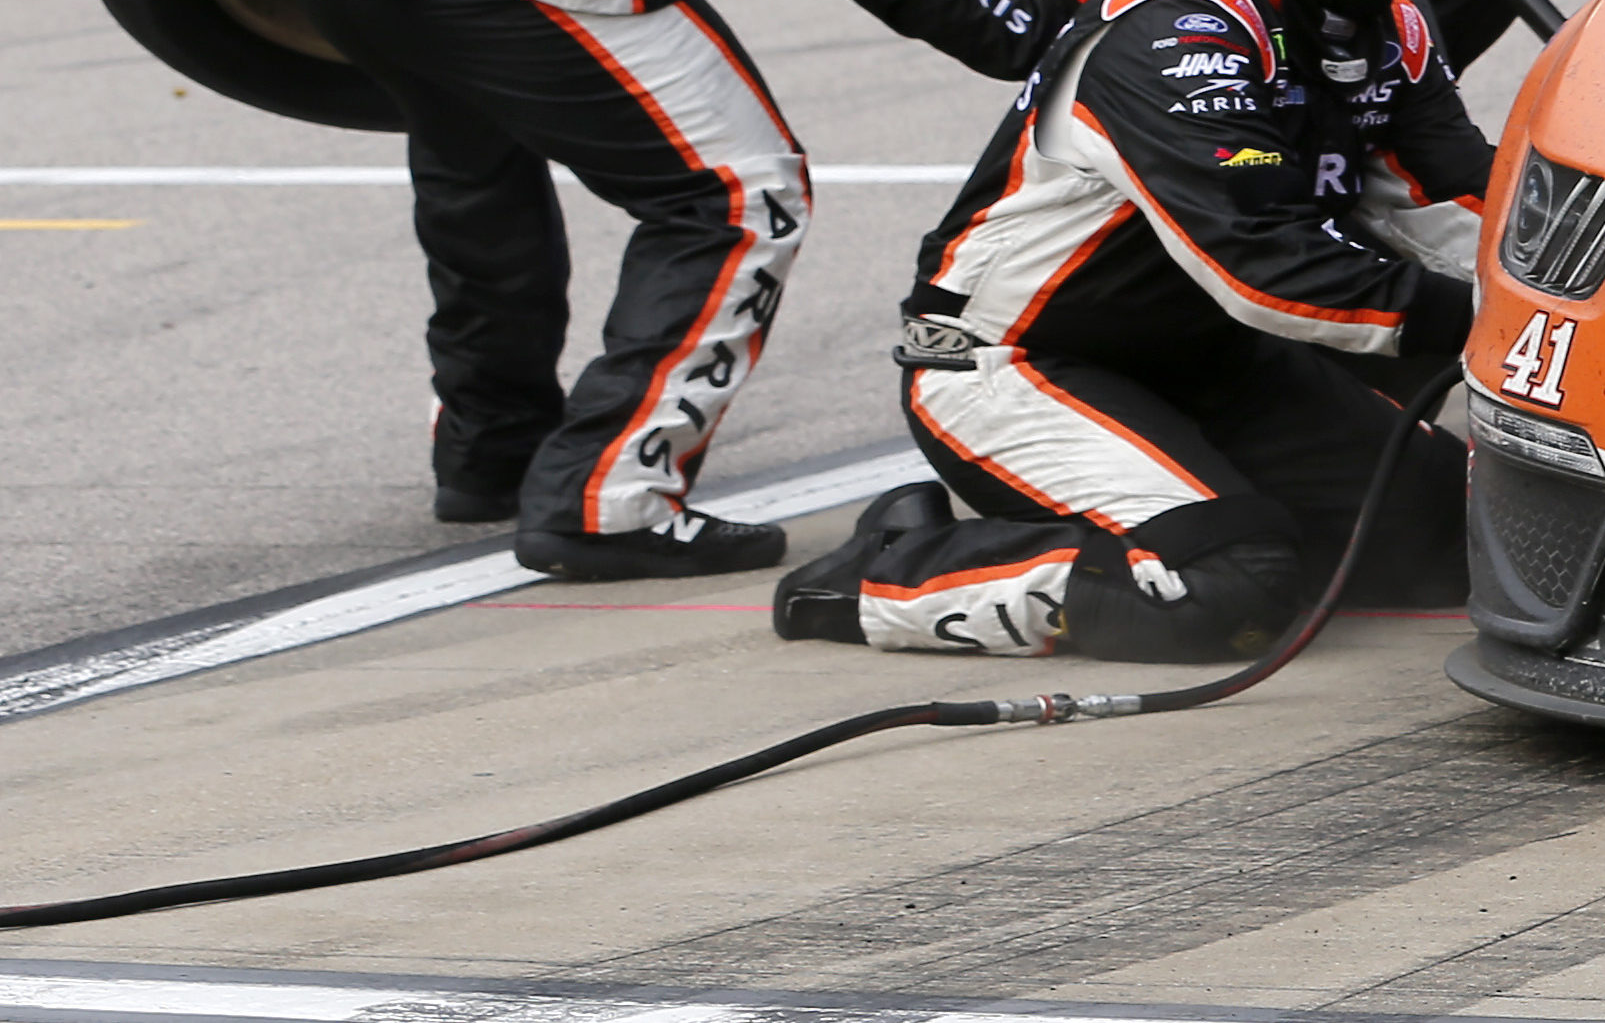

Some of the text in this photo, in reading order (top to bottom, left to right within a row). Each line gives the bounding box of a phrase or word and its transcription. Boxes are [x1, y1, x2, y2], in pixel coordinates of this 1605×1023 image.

[1162, 52, 1251, 79] HAAS
[1168, 95, 1258, 115] ARRIS
[638, 188, 799, 476] ARRIS
[1498, 308, 1577, 411] 41
